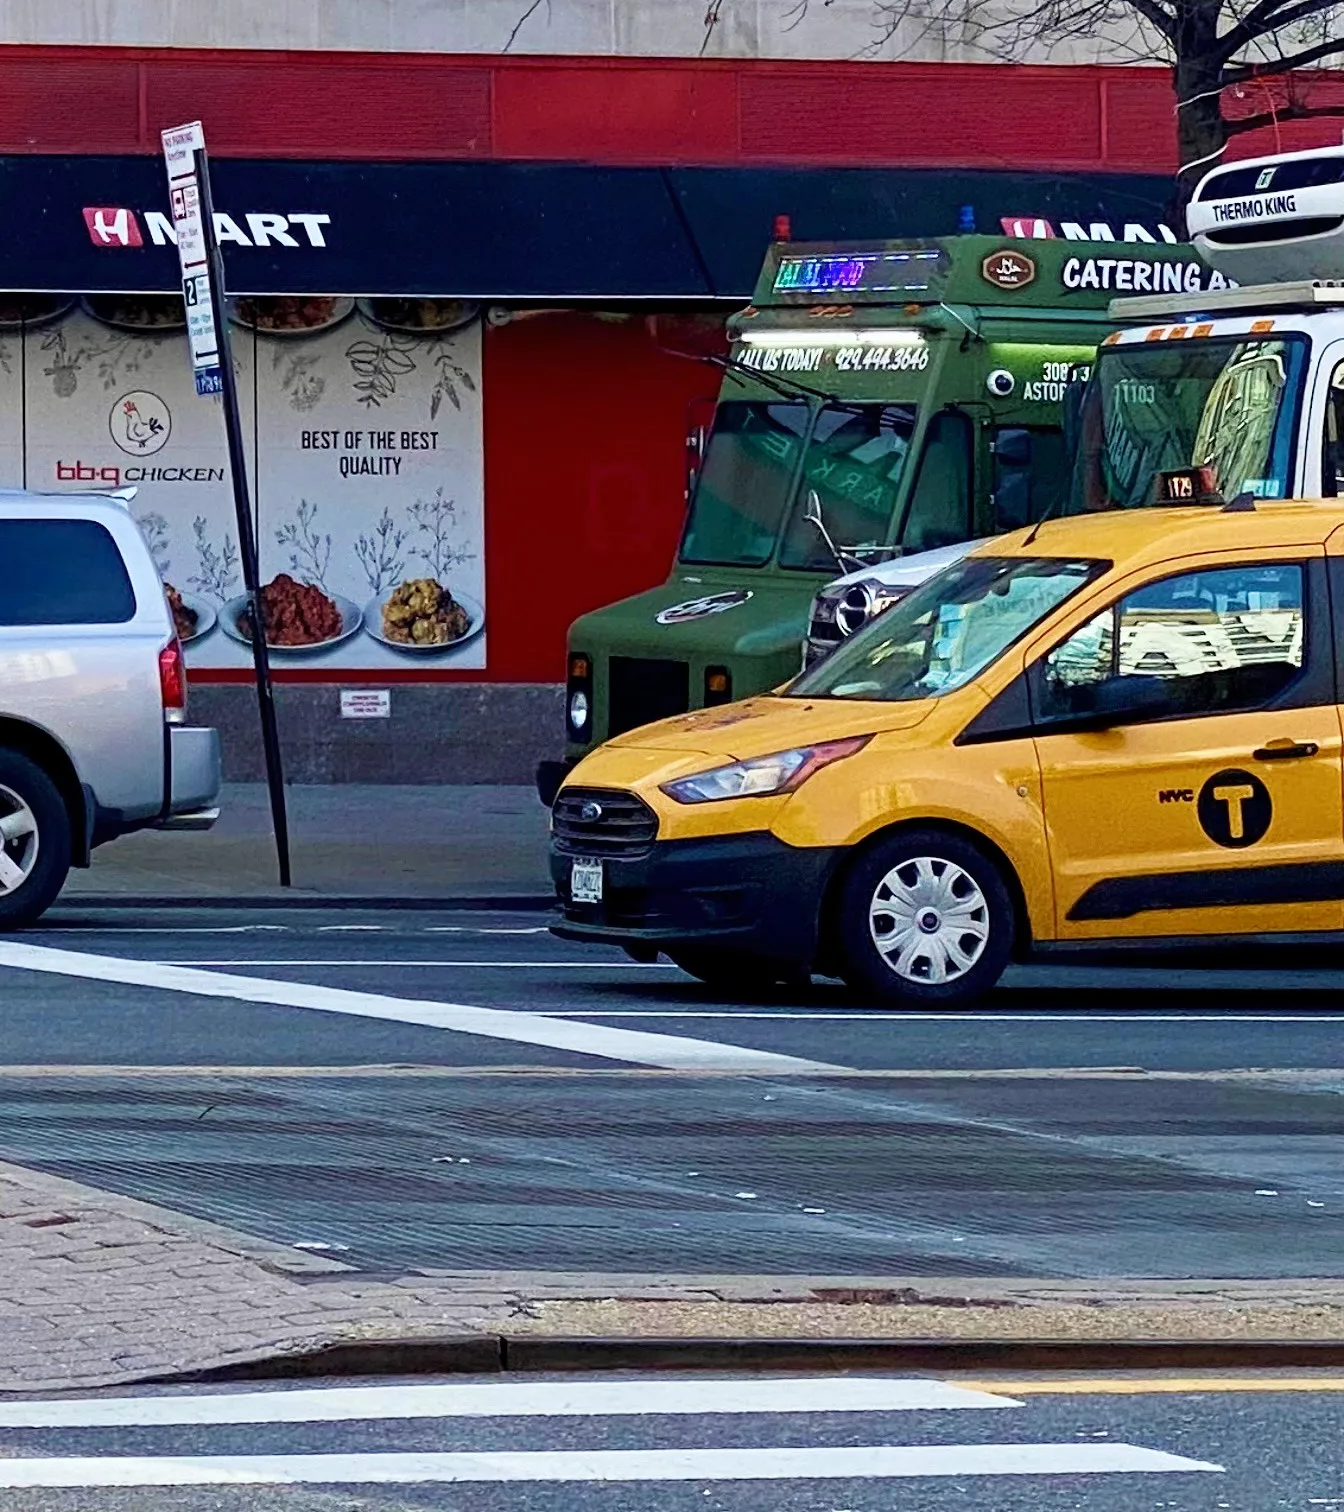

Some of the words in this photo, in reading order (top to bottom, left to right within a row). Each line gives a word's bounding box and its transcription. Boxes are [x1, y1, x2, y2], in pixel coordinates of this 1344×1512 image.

[1213, 200, 1262, 222] THERMO
[1265, 195, 1297, 215] KING
[93, 208, 128, 246] H
[1063, 258, 1201, 292] CATERING
[1208, 274, 1240, 292] A
[187, 280, 196, 305] 2
[737, 349, 761, 371] CALL
[762, 349, 782, 371] US
[781, 348, 824, 371] TODAY!
[301, 431, 340, 450] BEST
[344, 431, 363, 450] OF
[367, 431, 396, 450] THE
[401, 431, 439, 450] BEST
[125, 467, 224, 482] CHICKEN
[339, 456, 402, 478] QUALITY
[1159, 789, 1194, 804] NYC
[1213, 785, 1254, 839] T
